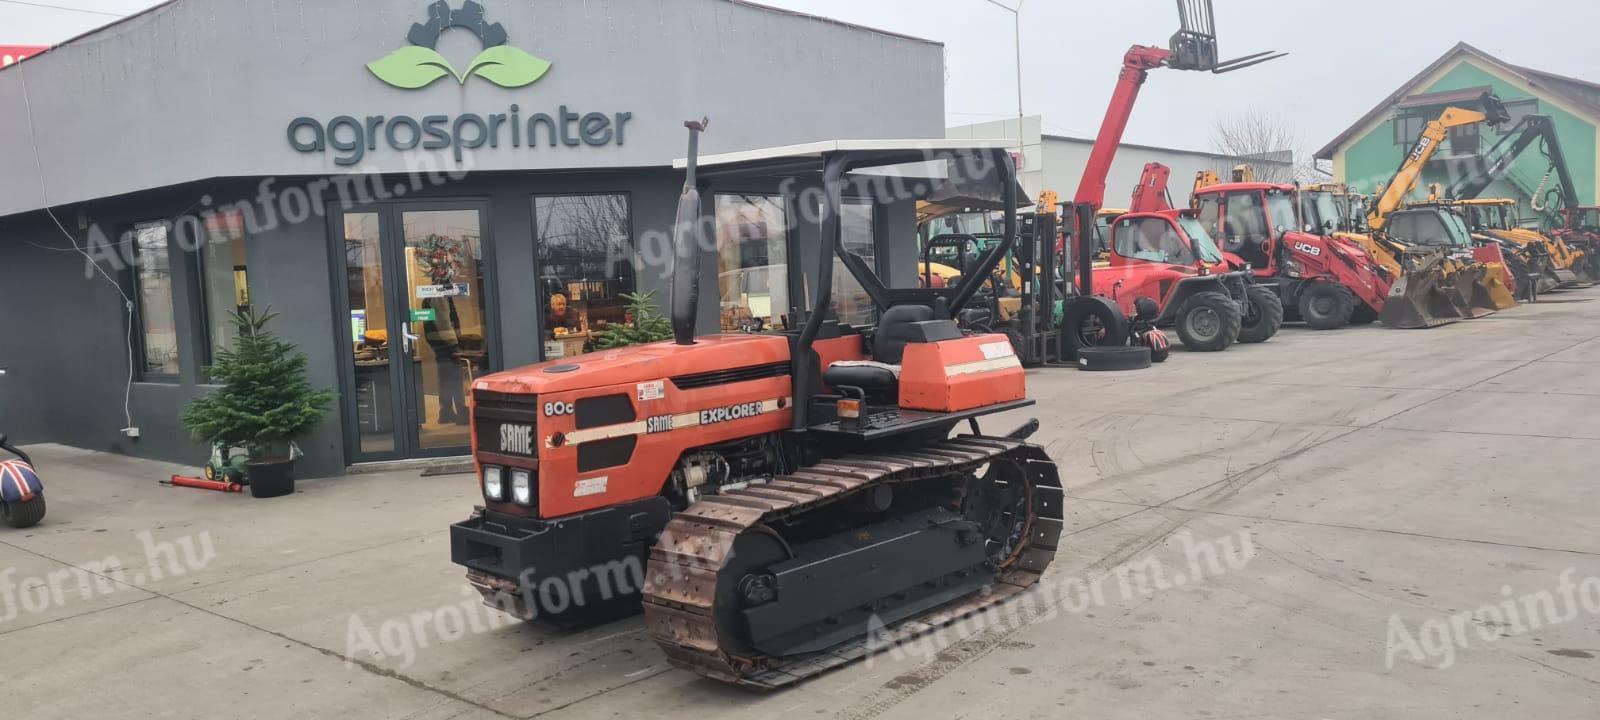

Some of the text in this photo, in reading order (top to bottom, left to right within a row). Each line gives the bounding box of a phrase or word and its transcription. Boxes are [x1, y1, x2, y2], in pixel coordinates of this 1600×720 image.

[287, 103, 632, 166] agrosprinter
[1409, 136, 1431, 161] JCB
[1294, 241, 1321, 256] JCB
[647, 414, 673, 433] SAME
[700, 401, 764, 425] EXPLORER
[500, 423, 533, 455] SAME
